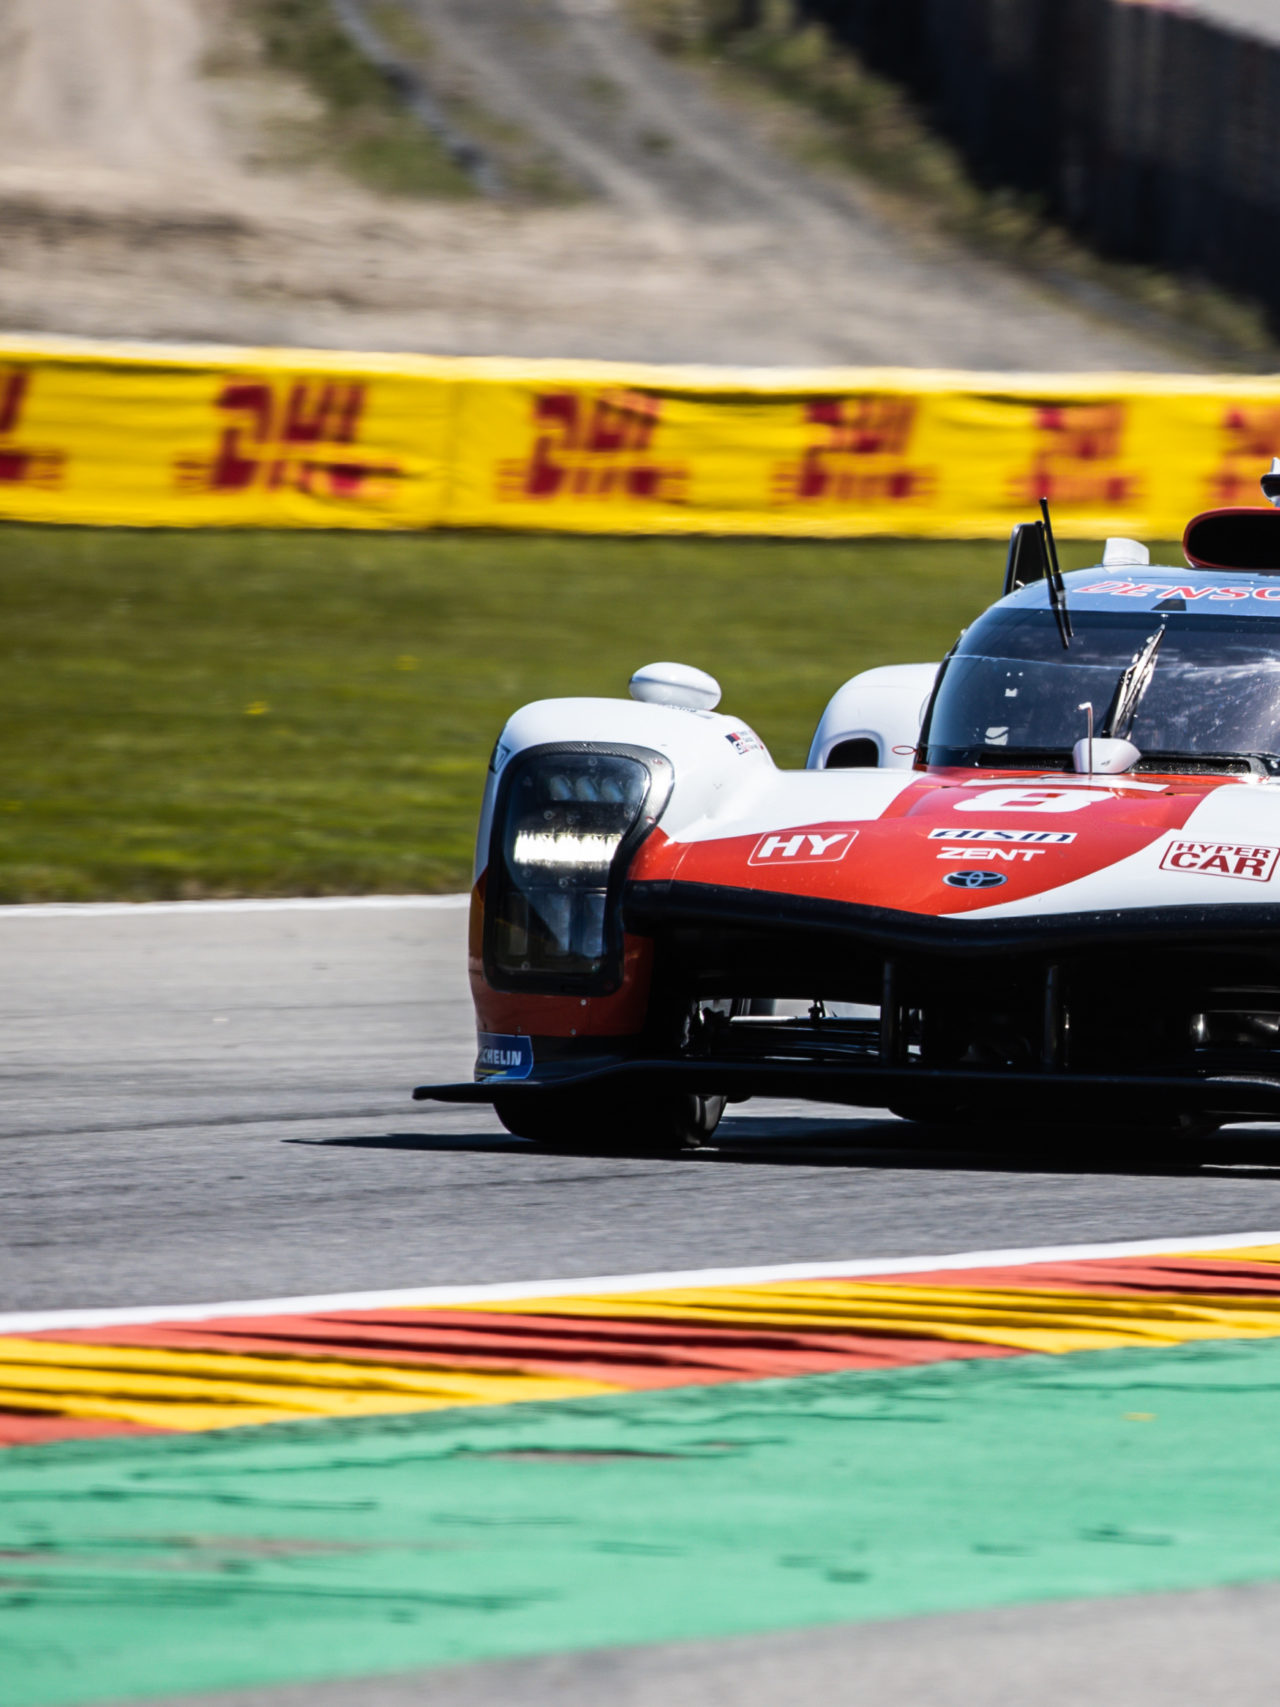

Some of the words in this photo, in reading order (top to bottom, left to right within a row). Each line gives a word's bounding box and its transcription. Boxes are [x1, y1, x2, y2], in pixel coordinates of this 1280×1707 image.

[953, 788, 1117, 813] 8
[934, 830, 1071, 842] AISIN
[757, 834, 848, 858] HY
[936, 847, 1046, 861] ZENT
[1176, 843, 1271, 858] HYPER
[1170, 852, 1266, 877] CAR
[479, 1048, 522, 1066] CHELIN
